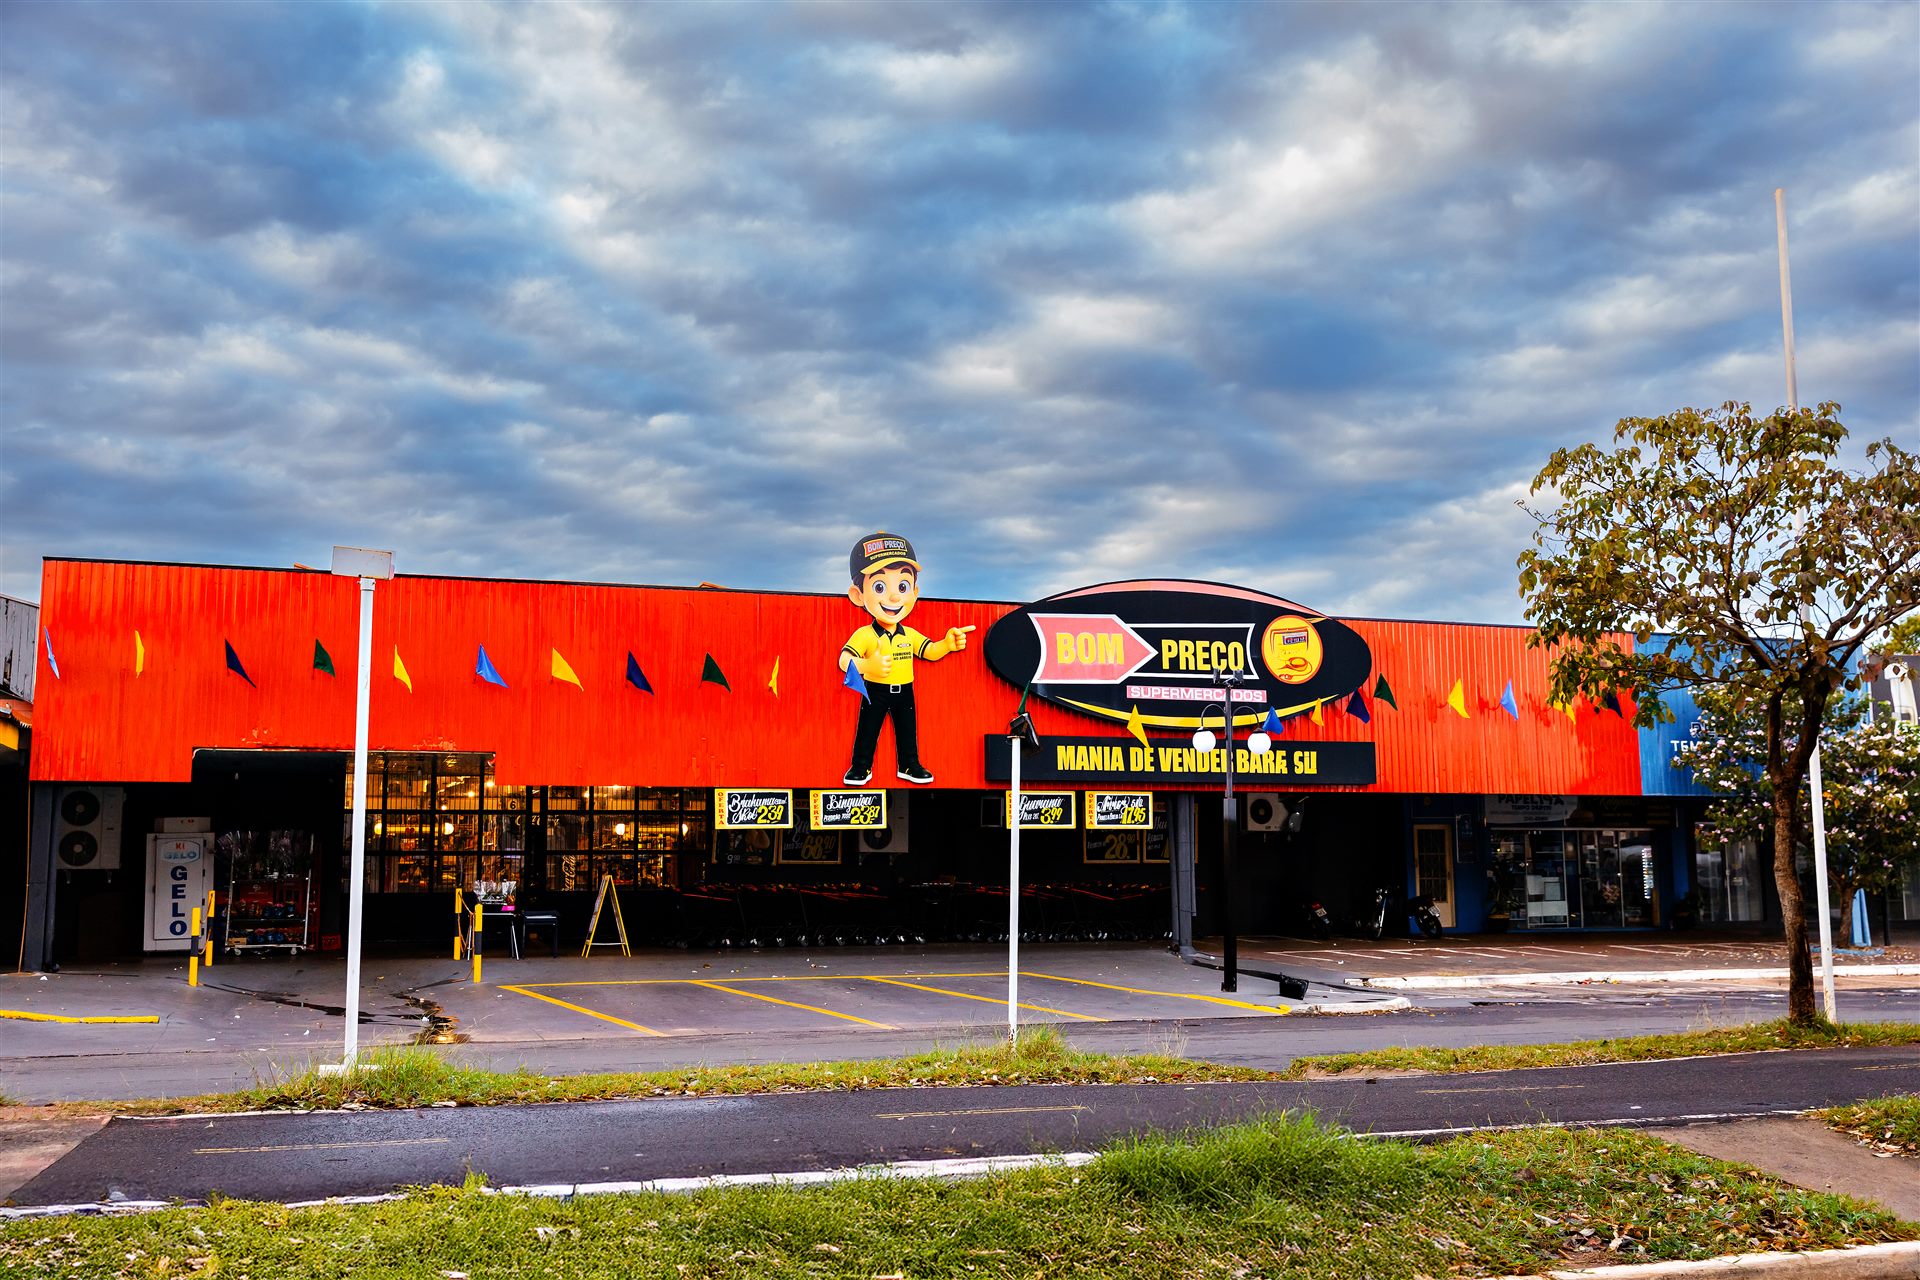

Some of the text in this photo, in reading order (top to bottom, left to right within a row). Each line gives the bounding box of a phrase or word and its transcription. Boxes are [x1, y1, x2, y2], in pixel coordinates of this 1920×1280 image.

[867, 540, 905, 552] BOM PREÇO
[1056, 632, 1124, 664] BOM
[1057, 745, 1124, 771] MANIA
[1130, 746, 1154, 772] DE
[1158, 747, 1234, 773] VENDER
[510, 801, 517, 810] 6
[812, 793, 820, 827] OFERTA
[164, 851, 197, 860] GELO
[175, 842, 185, 850] KI
[169, 865, 188, 936] GELO
